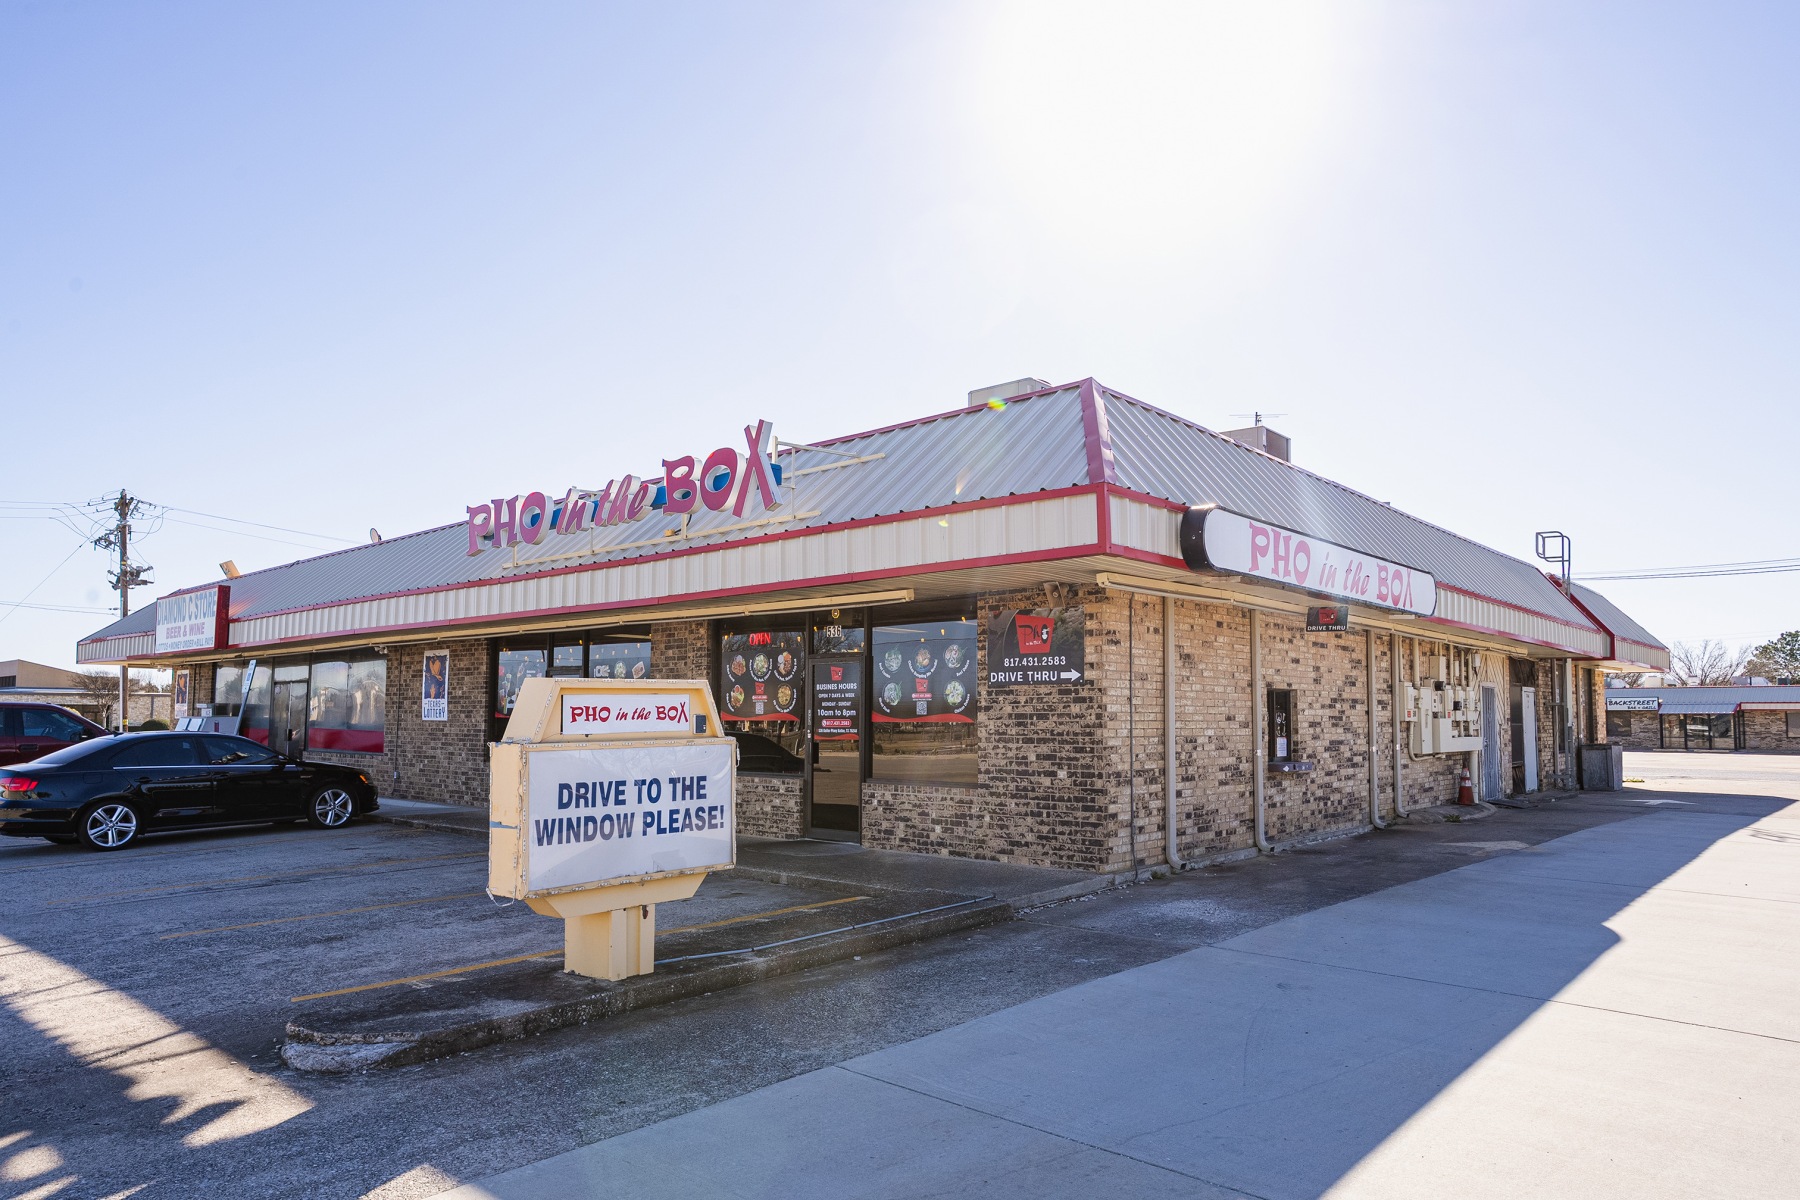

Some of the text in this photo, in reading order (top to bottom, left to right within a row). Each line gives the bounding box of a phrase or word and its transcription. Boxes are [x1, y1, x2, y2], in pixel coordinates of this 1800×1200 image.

[466, 419, 783, 557] PHO in the BOX
[1249, 521, 1413, 609] PHO in the BOX
[157, 590, 217, 626] DIAMOND C STORE
[166, 621, 205, 640] BEER & WINE
[827, 626, 841, 637] 536
[749, 632, 772, 646] OPEN
[1003, 656, 1066, 667] 817.431.2583
[990, 670, 1058, 682] DRIVE THRU
[838, 682, 857, 690] HOURS
[423, 707, 445, 718] LOTTERY
[570, 701, 689, 724] PHO in the BOX
[817, 708, 856, 717] 10am to 8pm
[557, 775, 707, 810] DRIVE TO THE
[534, 804, 725, 847] WINDOW PLEASE!
